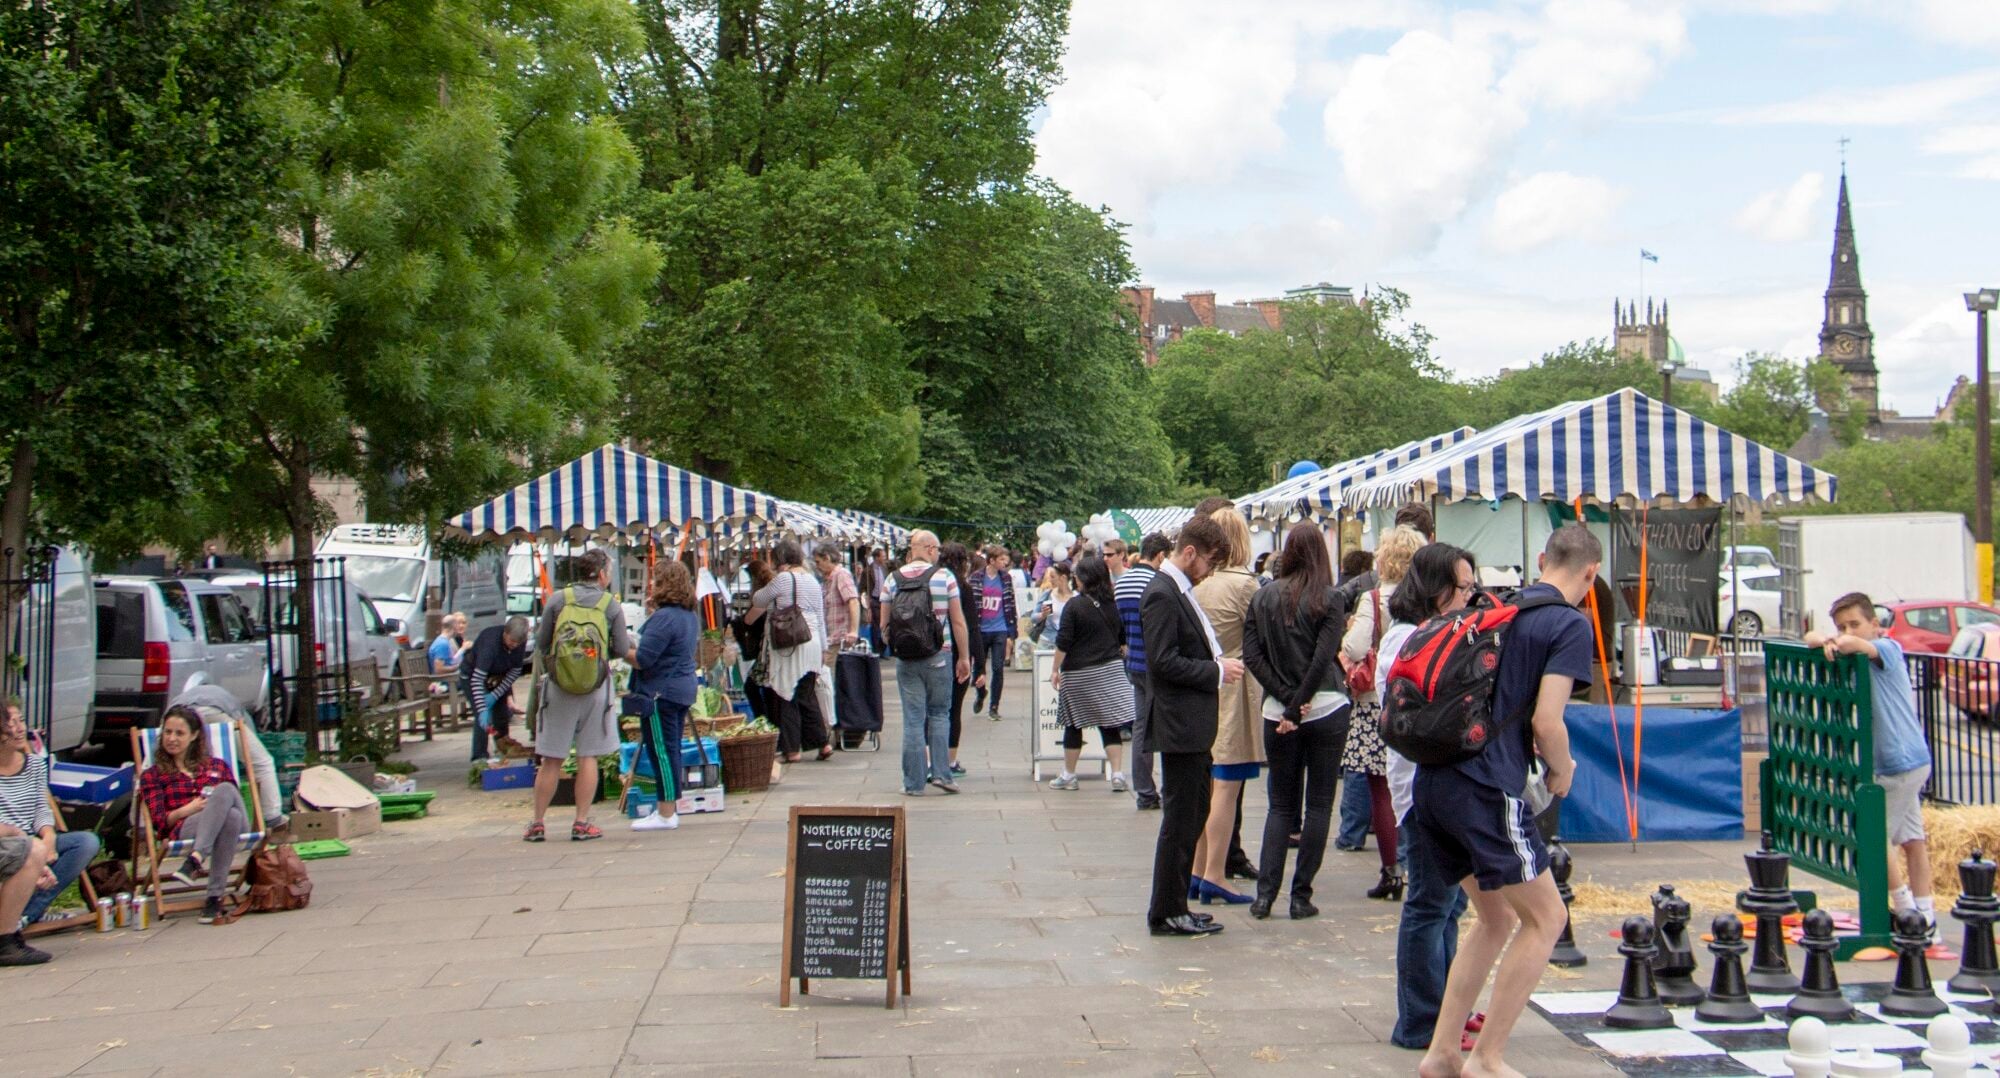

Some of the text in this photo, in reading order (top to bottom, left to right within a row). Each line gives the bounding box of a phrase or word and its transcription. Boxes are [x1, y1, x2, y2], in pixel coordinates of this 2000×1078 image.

[1686, 522, 1719, 552] EDGE
[1647, 562, 1689, 592] COFFEE
[802, 824, 893, 840] NORTHERN EDGE
[825, 839, 872, 851] COFFEE
